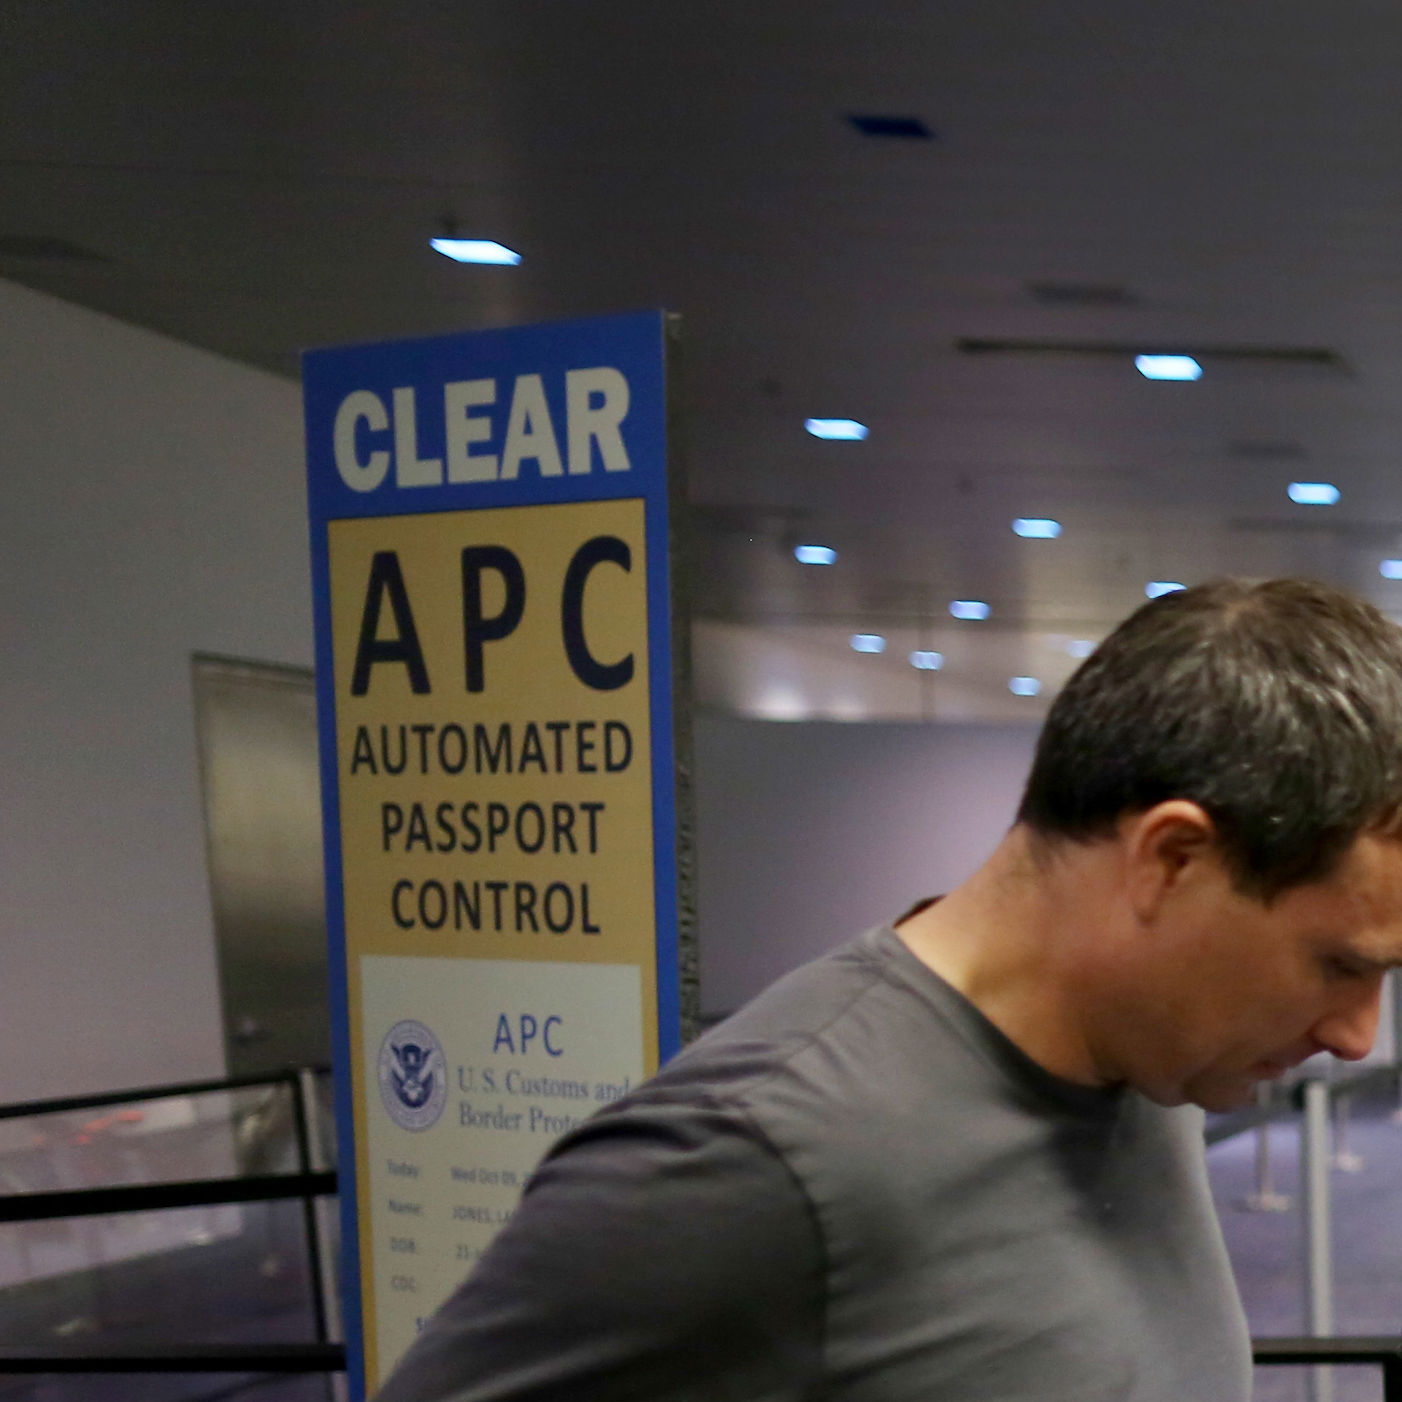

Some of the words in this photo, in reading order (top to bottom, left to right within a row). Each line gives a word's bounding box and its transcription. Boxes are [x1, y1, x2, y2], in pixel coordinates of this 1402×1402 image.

[333, 366, 632, 493] CLEAR
[350, 719, 634, 776] AUTOMATED
[382, 801, 606, 855] PASSPORT
[391, 879, 601, 934] CONTROL
[492, 1011, 564, 1056] APC
[505, 1069, 589, 1099] Customs
[459, 1102, 522, 1133] Border
